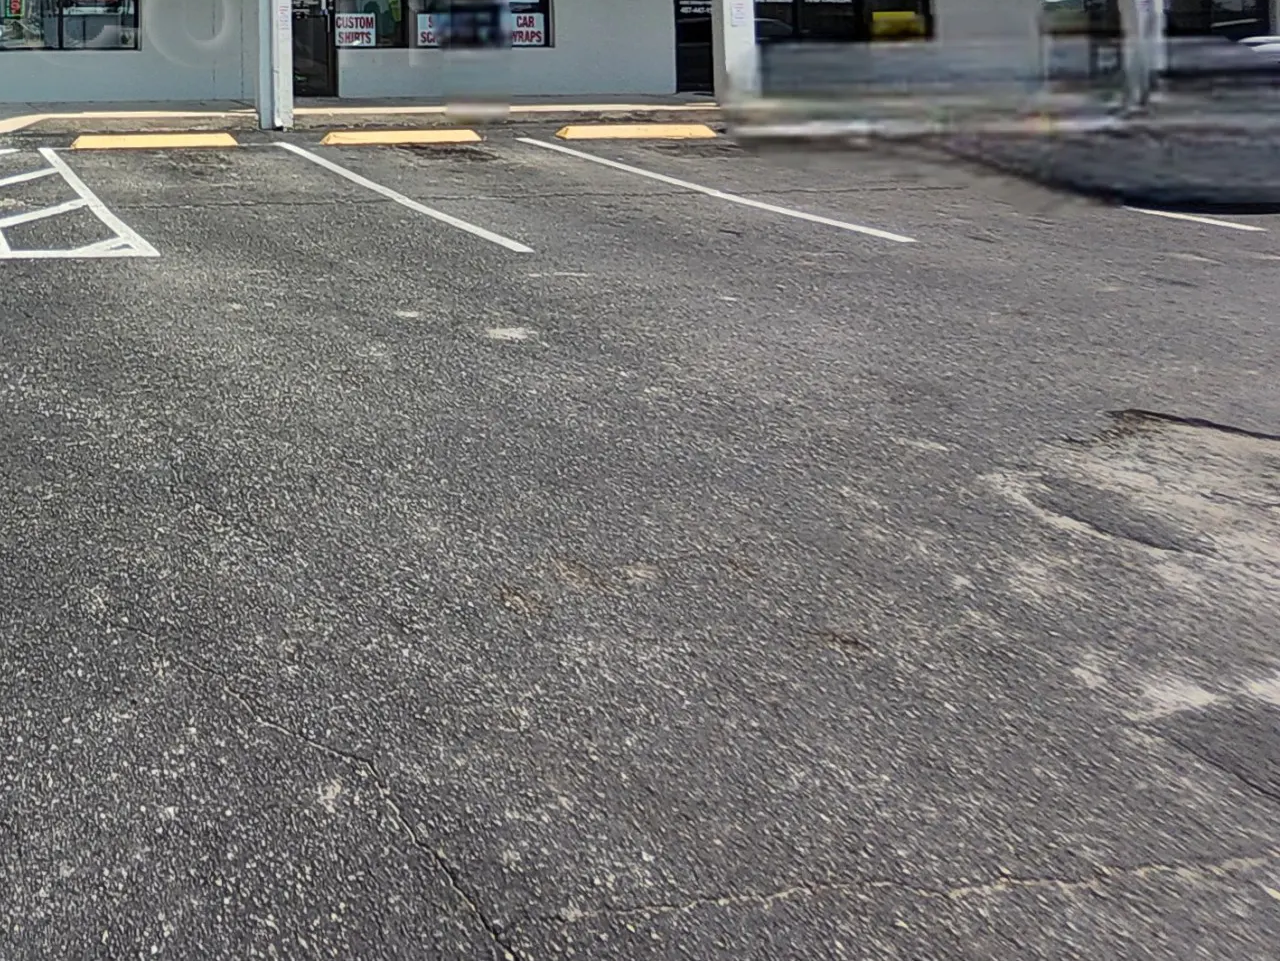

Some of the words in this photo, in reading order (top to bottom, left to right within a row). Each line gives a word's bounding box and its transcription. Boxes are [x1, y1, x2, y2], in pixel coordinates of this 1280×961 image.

[335, 16, 374, 29] CUSTOM
[516, 15, 535, 28] CAR
[338, 31, 372, 44] SHIRTS
